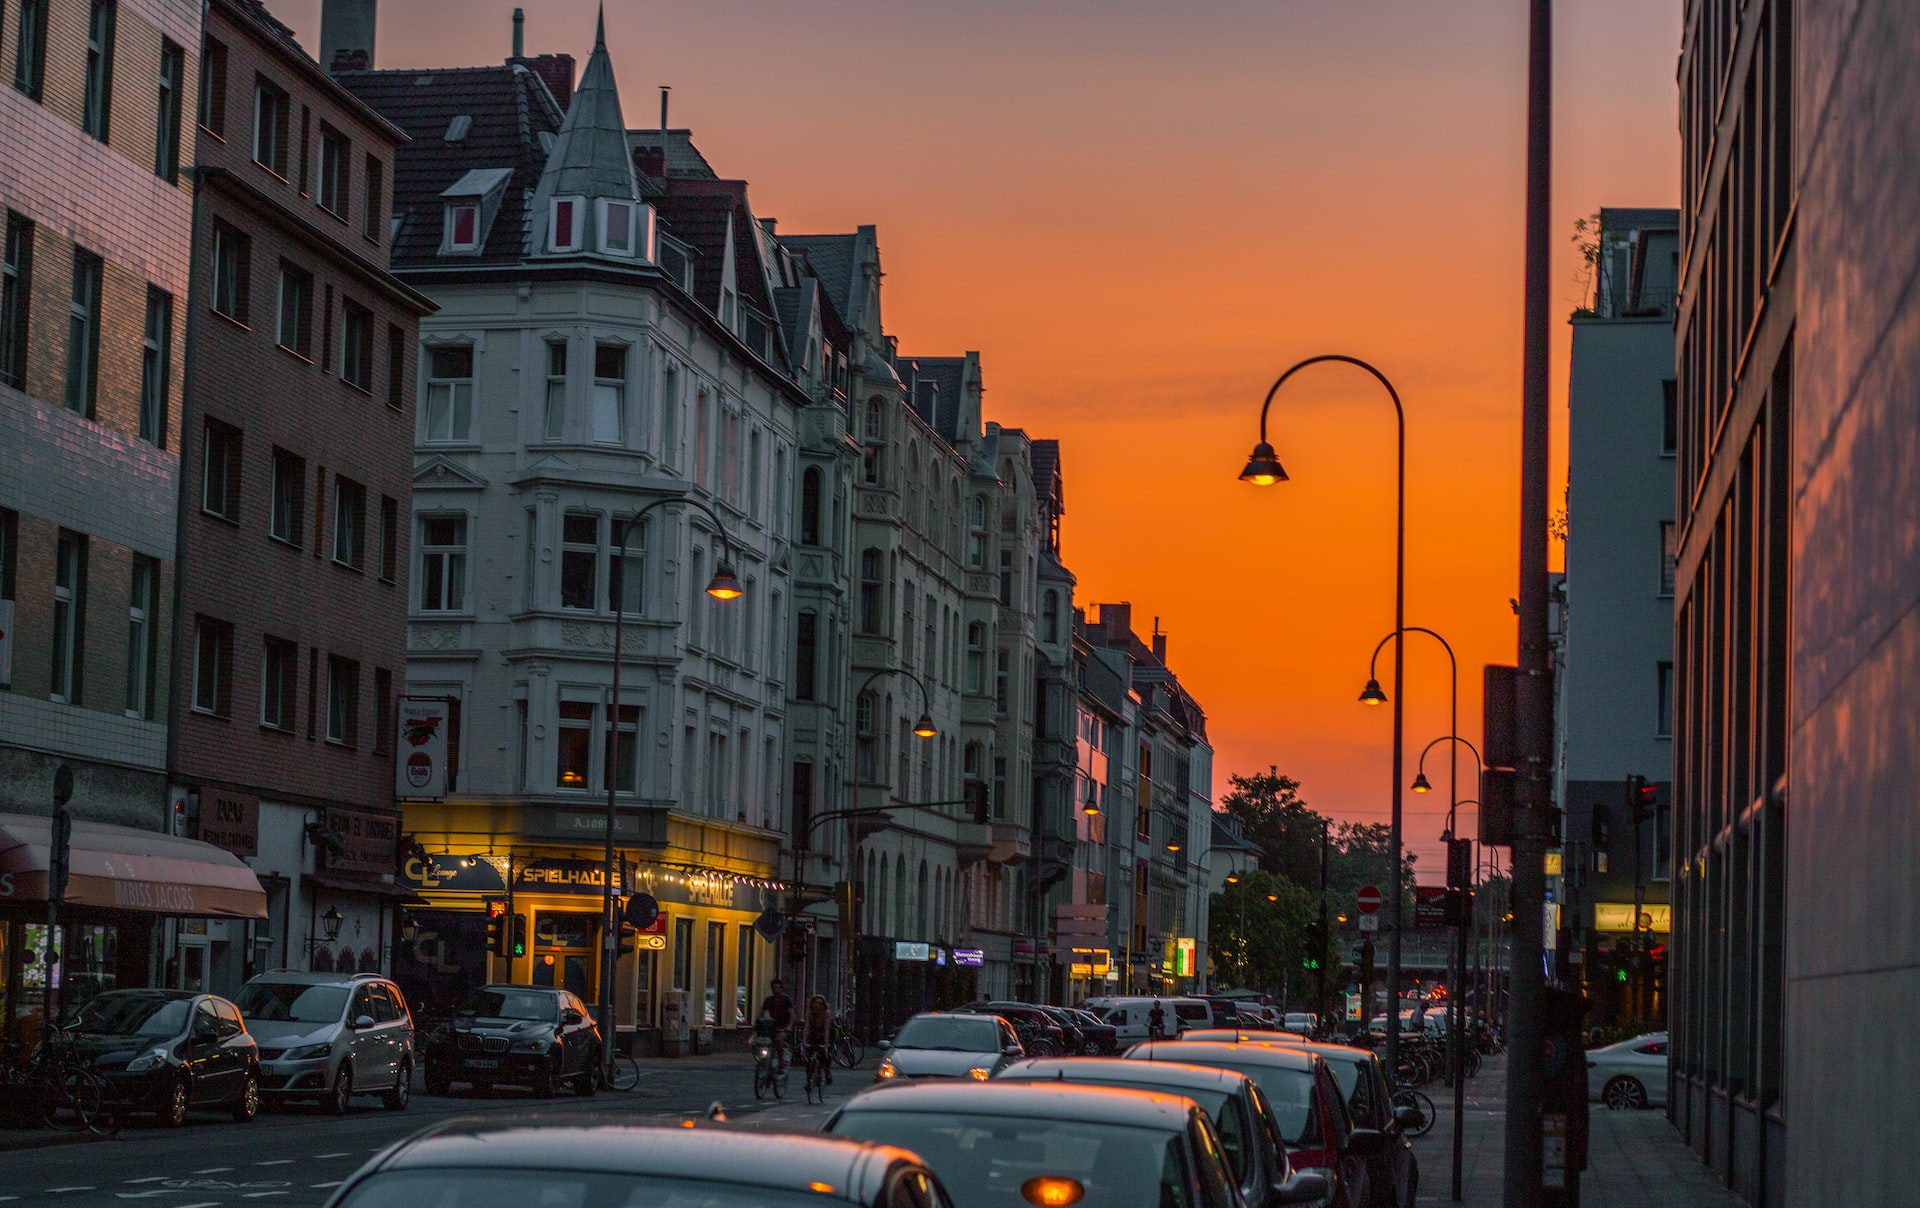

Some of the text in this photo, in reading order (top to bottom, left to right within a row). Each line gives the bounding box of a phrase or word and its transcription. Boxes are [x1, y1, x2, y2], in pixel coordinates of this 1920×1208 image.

[522, 867, 622, 887] SPIELHALLE
[115, 879, 194, 910] IMBISS JACOBS
